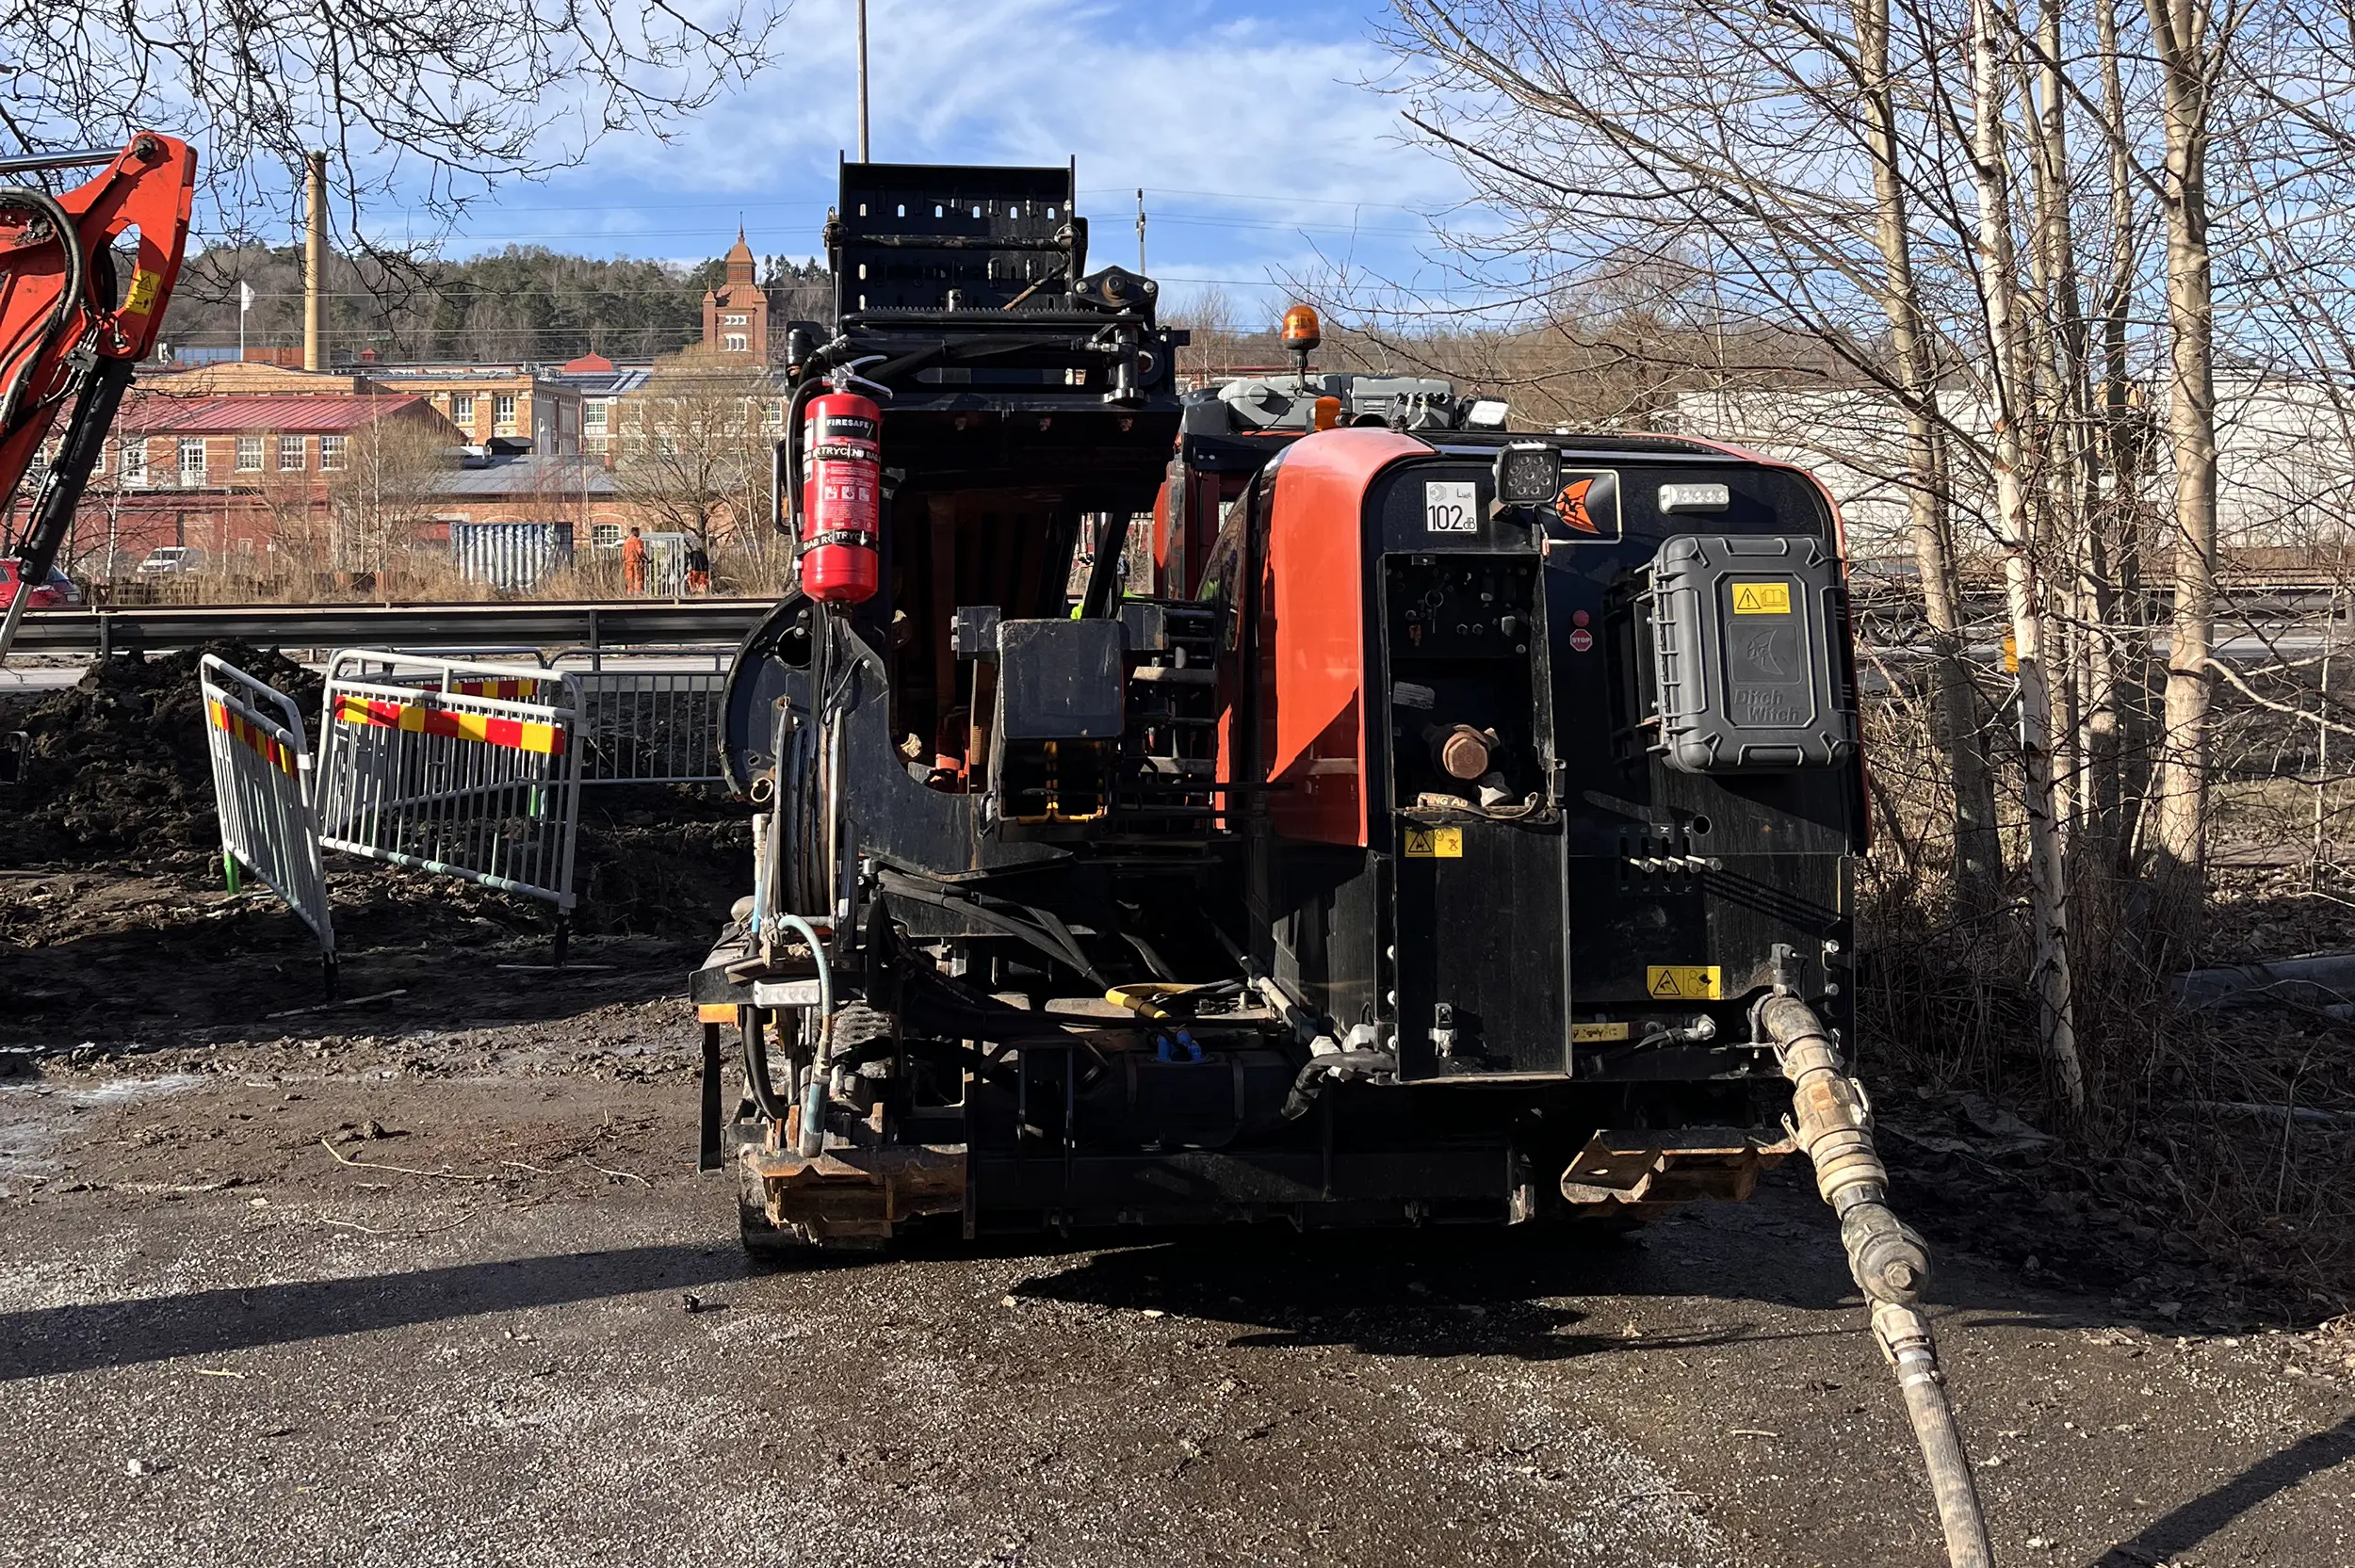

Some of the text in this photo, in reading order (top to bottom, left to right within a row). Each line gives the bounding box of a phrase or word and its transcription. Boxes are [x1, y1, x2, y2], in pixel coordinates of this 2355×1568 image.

[826, 418, 869, 428] FIRESAFE
[1428, 504, 1476, 530] 102 dB
[1733, 688, 1782, 705] Ditch
[1746, 704, 1798, 721] Witch
